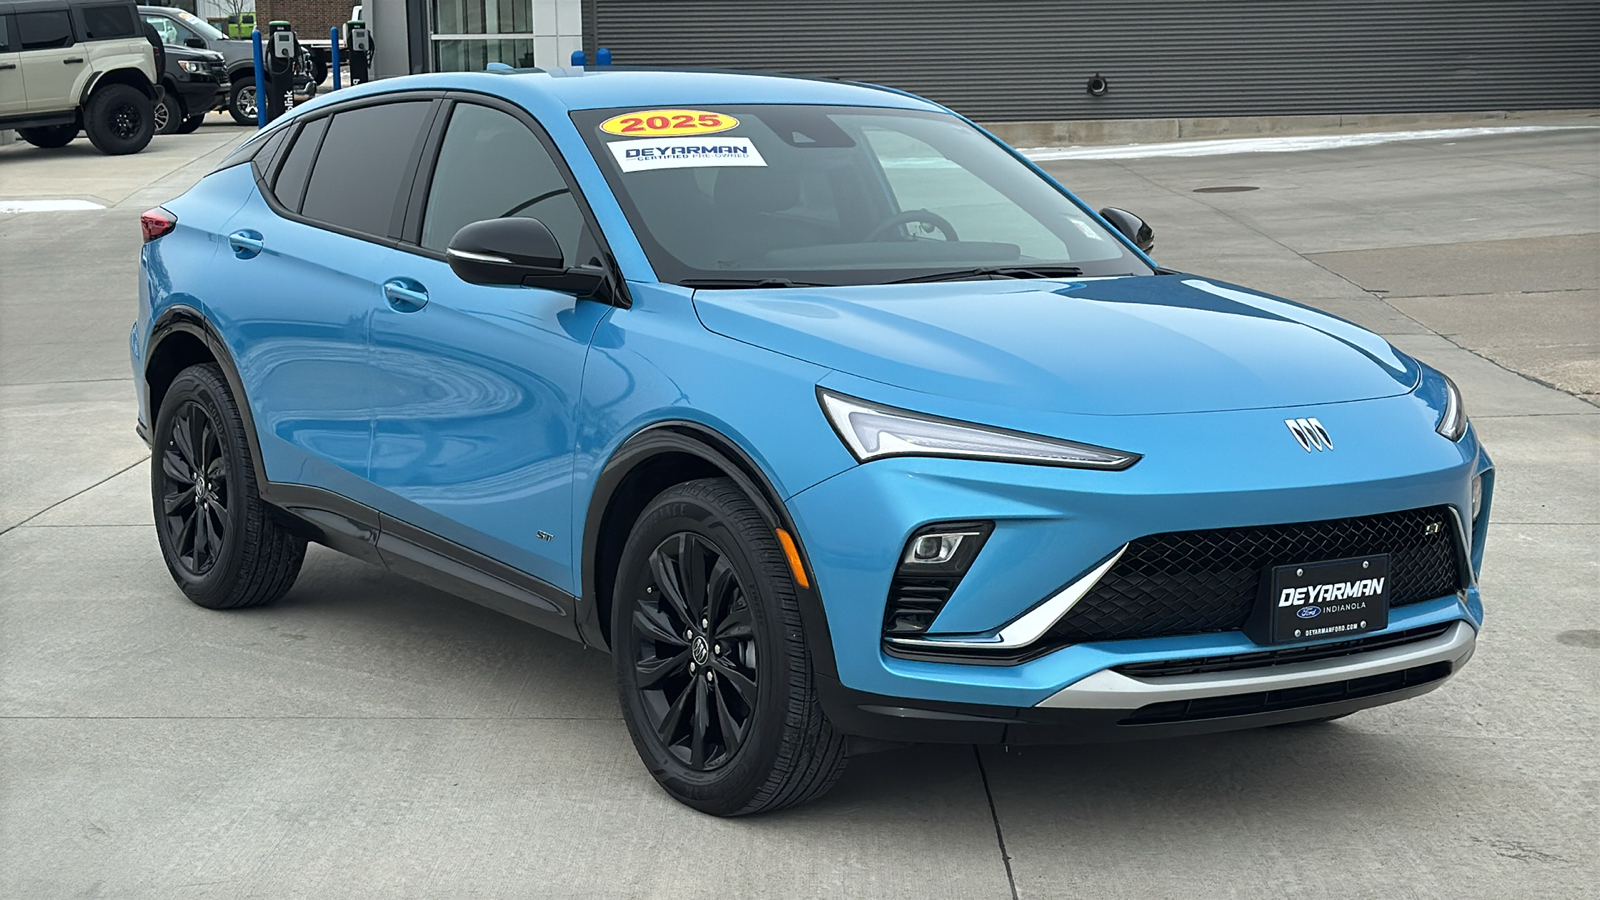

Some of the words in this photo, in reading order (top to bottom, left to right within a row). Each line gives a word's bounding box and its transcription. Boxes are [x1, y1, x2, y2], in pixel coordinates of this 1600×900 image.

[620, 114, 723, 133] 2025
[625, 146, 748, 158] DEYARMAN
[536, 529, 554, 541] ST
[1278, 577, 1385, 607] DEYARMAN
[1299, 606, 1319, 617] Ford
[1322, 602, 1366, 613] INDIANOLA
[1305, 623, 1358, 636] DEYARMANFORD.COM
